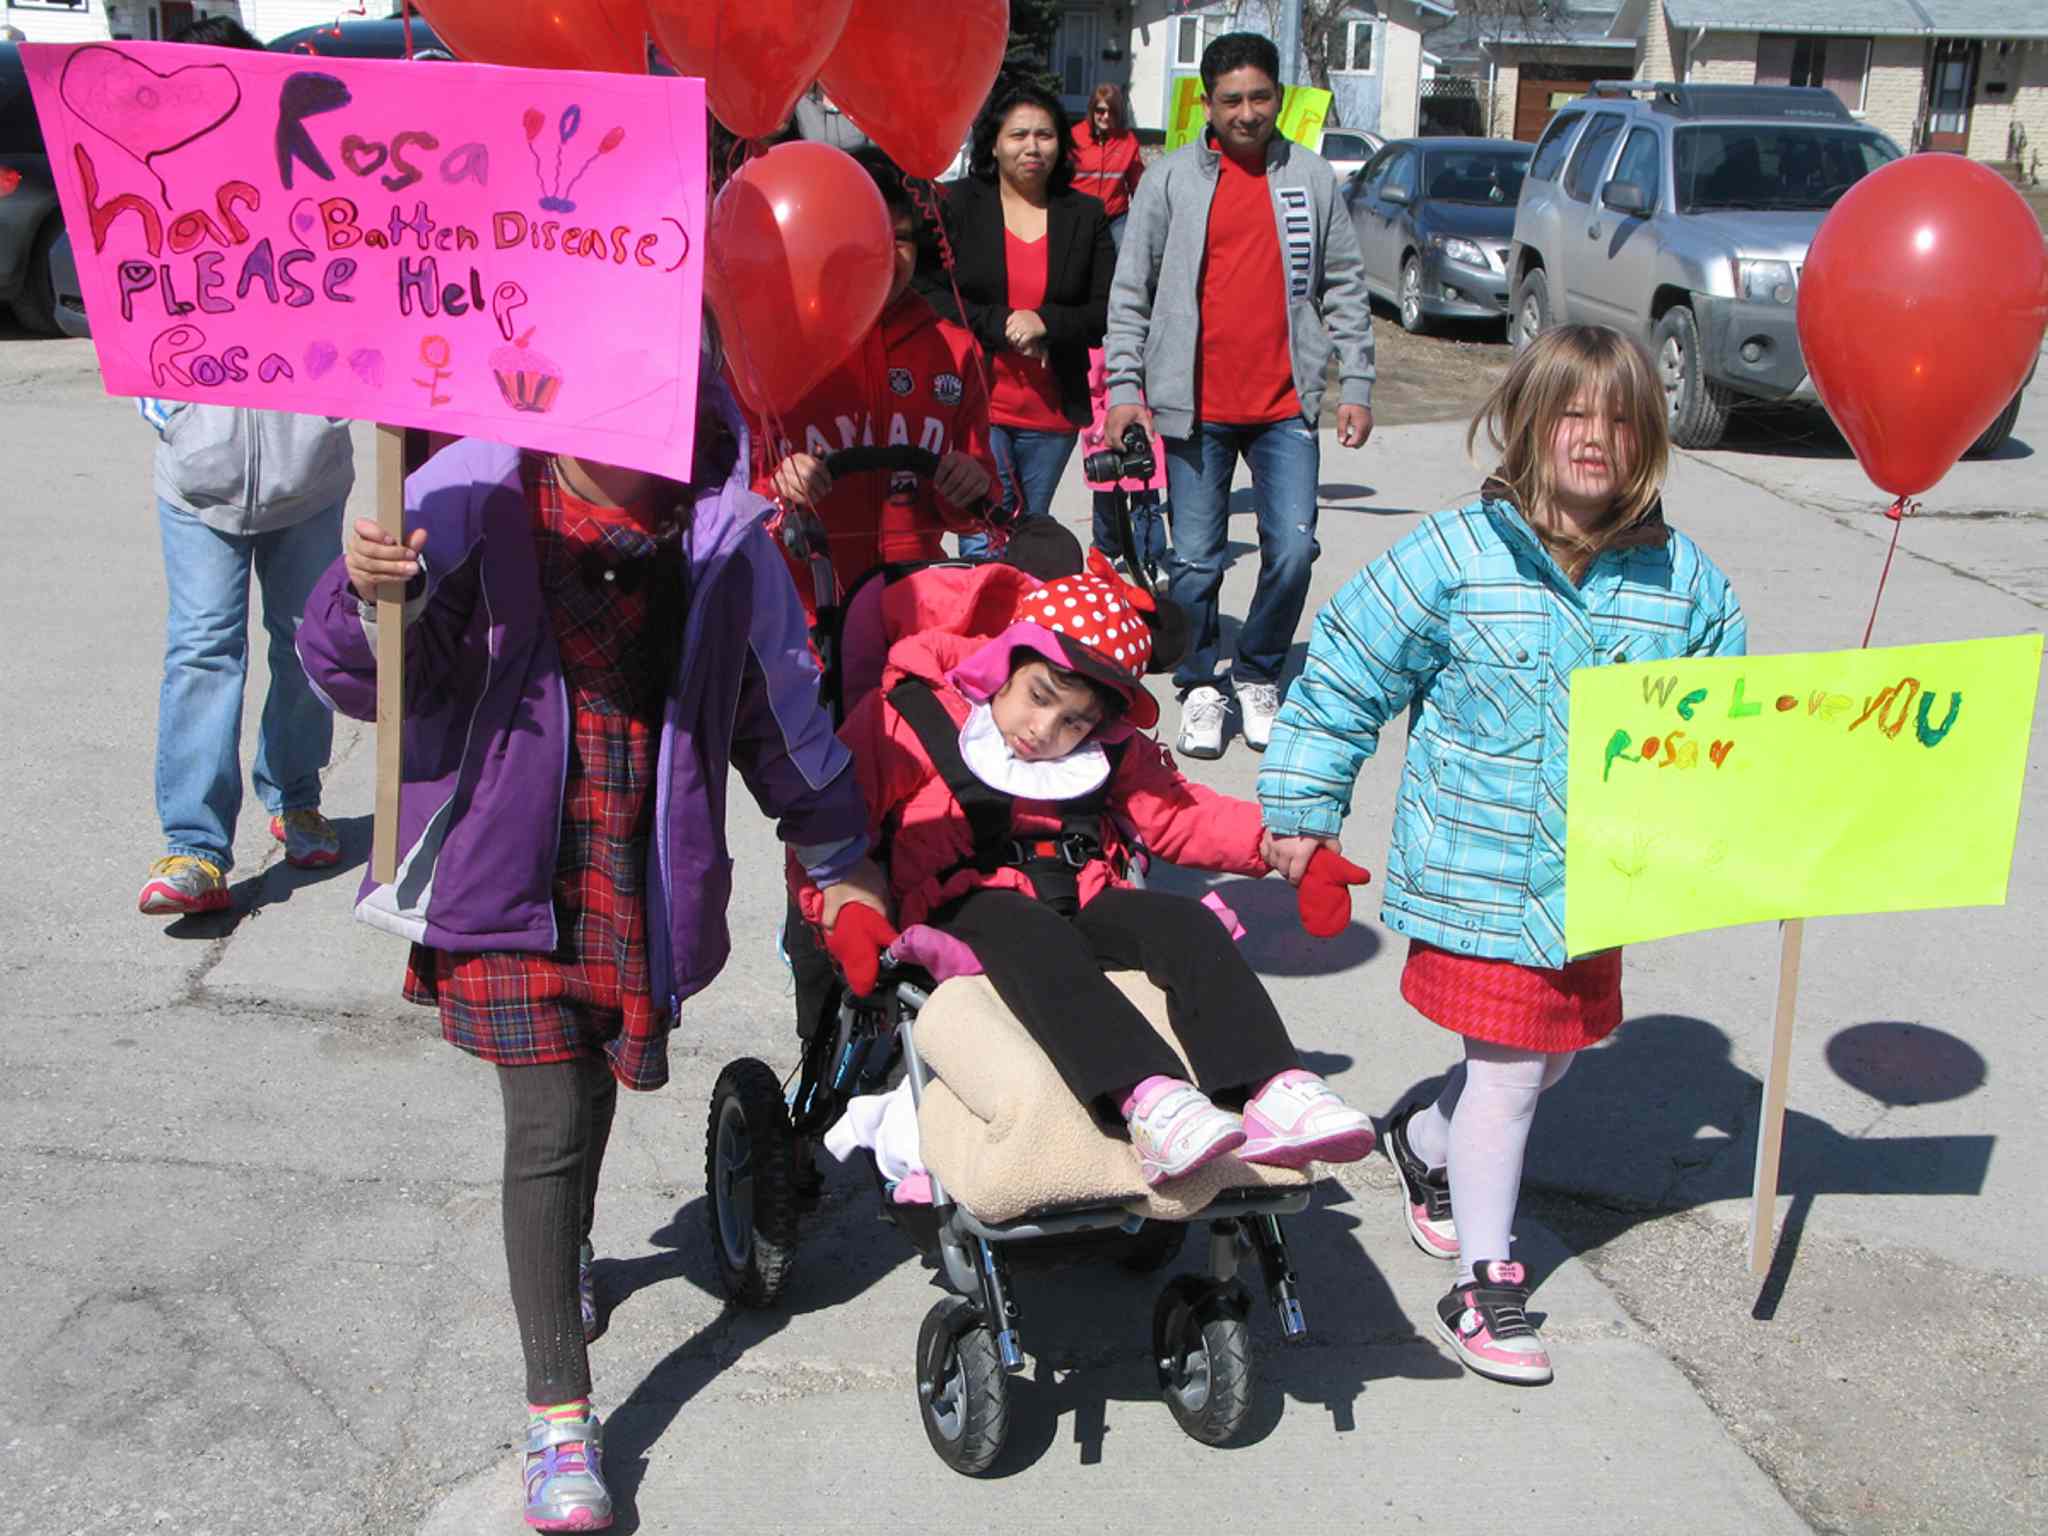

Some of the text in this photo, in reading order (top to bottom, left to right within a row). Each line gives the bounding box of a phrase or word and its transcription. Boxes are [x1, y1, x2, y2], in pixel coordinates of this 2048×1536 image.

[1280, 190, 1312, 297] PUMA
[399, 255, 529, 341] Help
[150, 324, 294, 387] Rosa
[778, 411, 953, 461] ANAD
[1643, 675, 1708, 721] We
